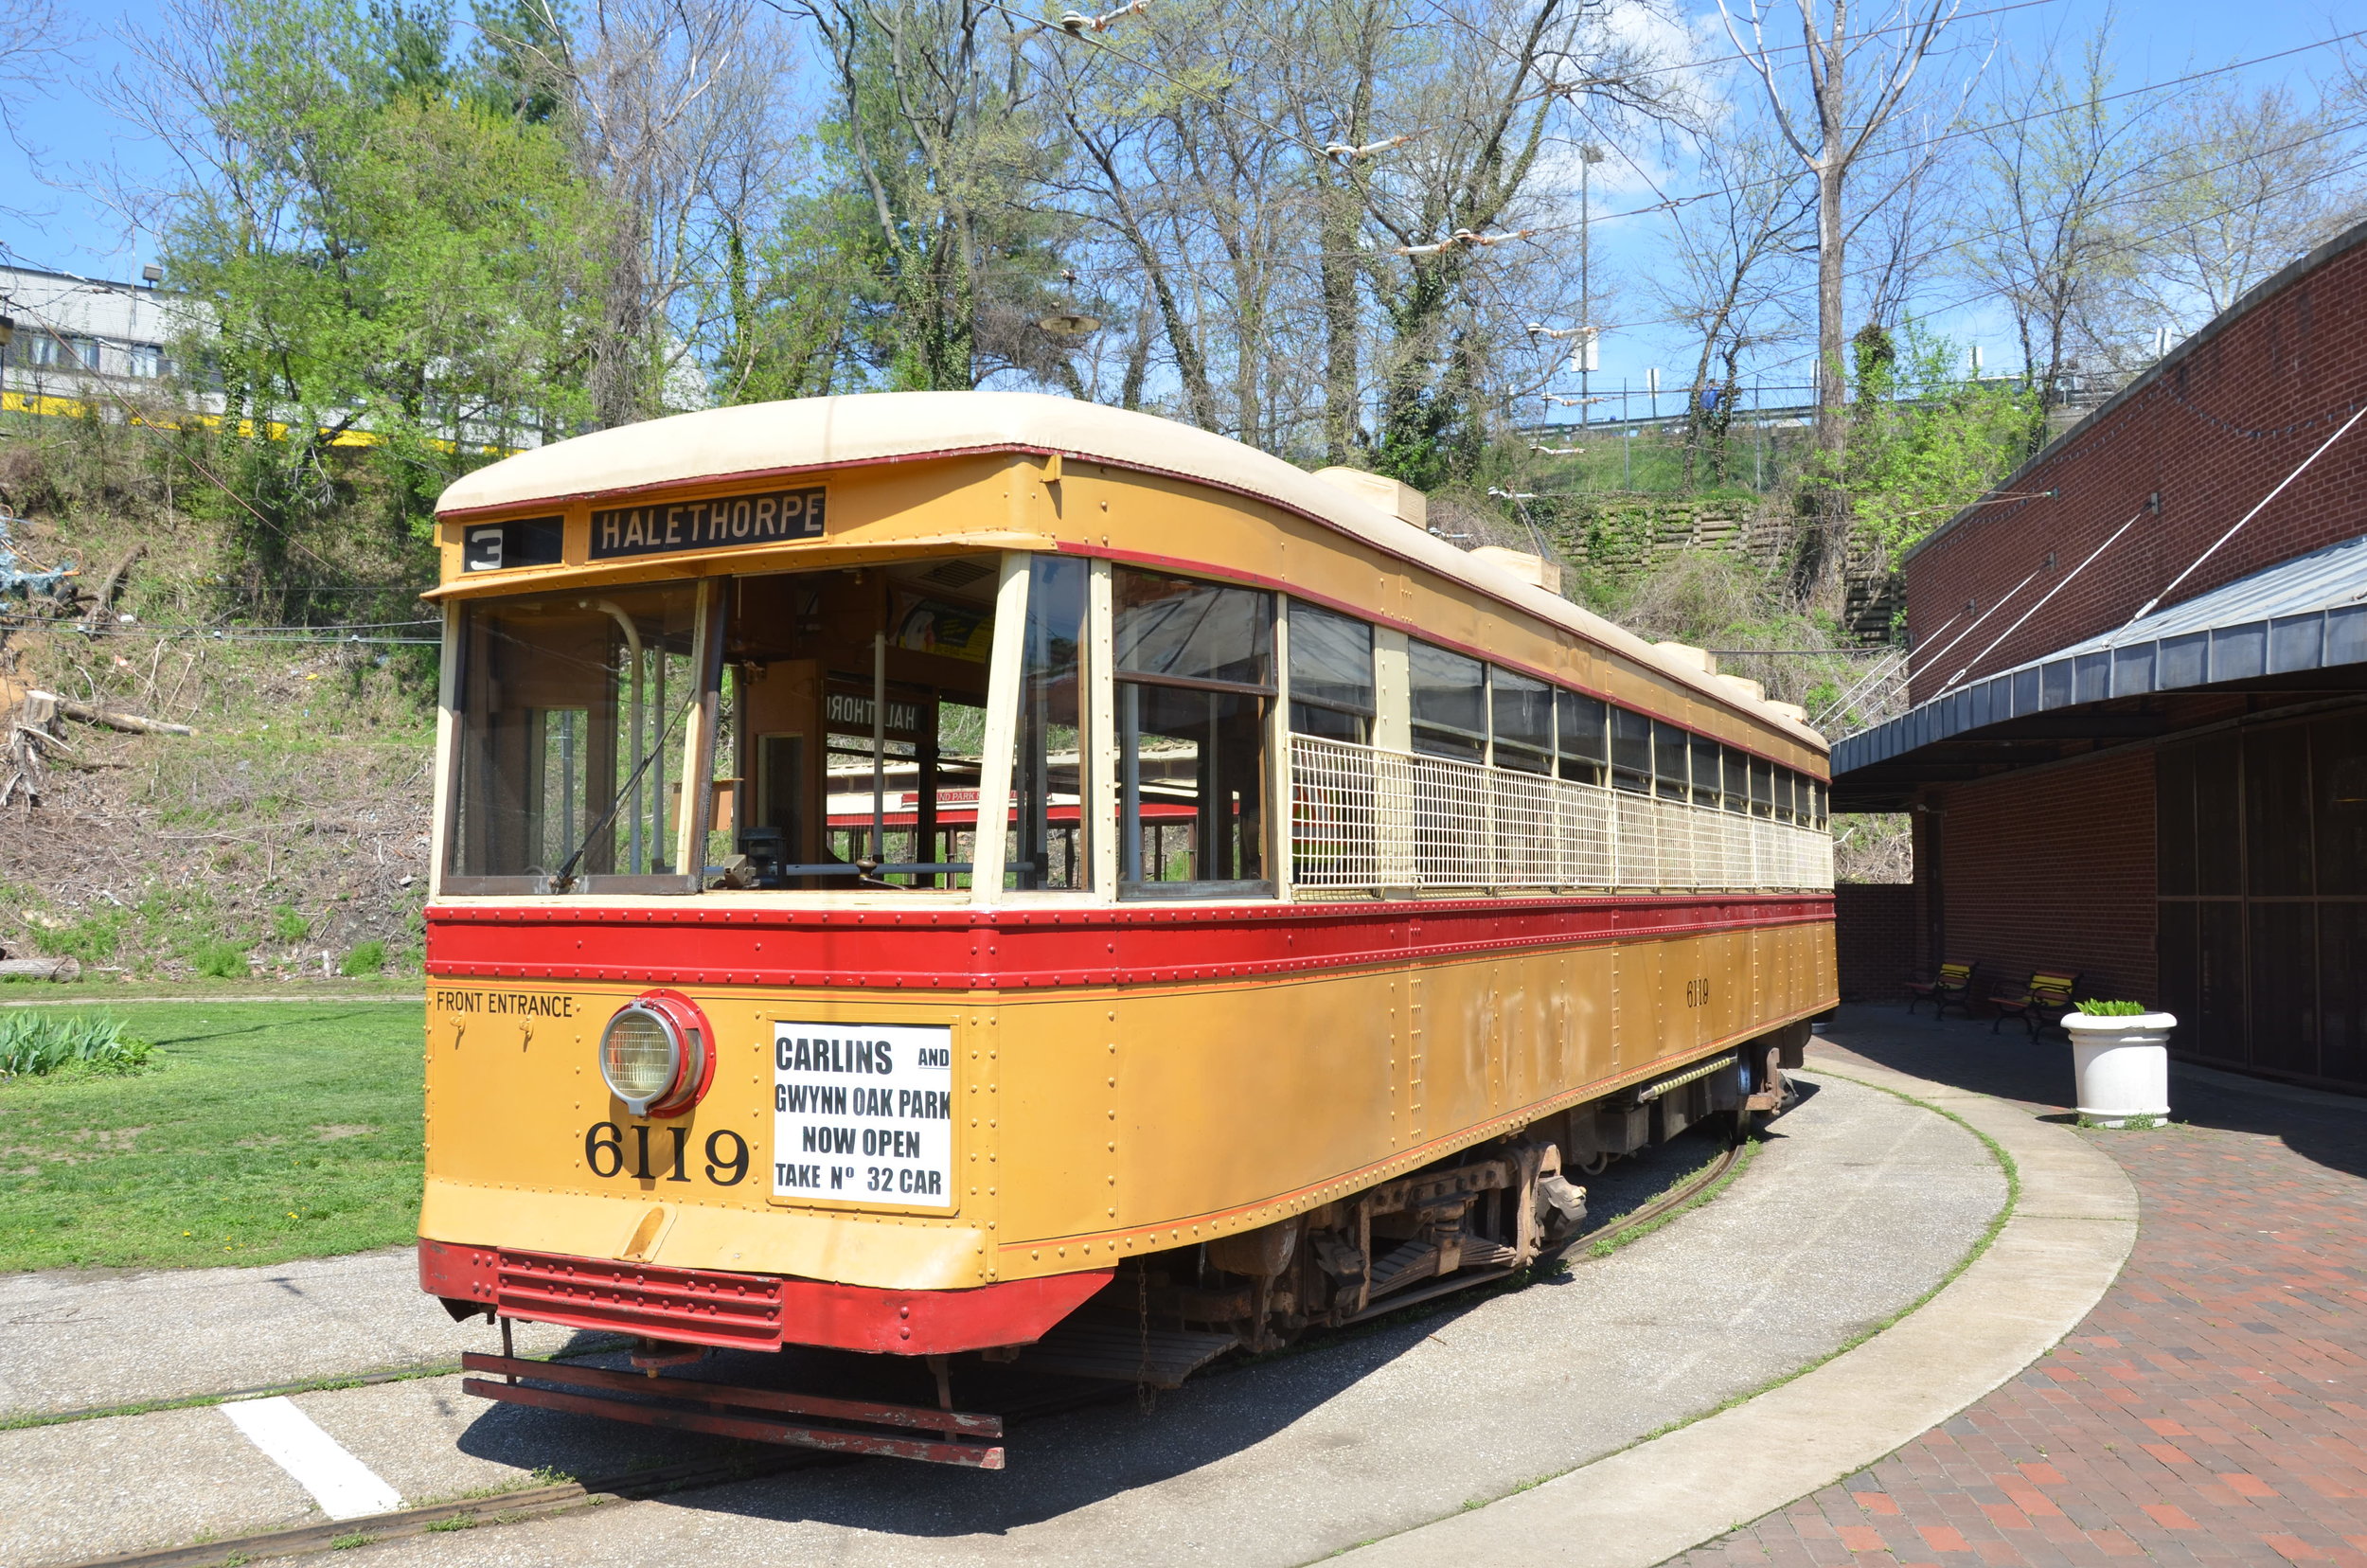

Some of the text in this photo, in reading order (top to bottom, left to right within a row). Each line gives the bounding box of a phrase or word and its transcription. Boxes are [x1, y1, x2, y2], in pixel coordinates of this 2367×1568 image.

[470, 492, 825, 571] 3 HALETHORPE
[436, 990, 573, 1018] FRONT ENTRANCE
[1686, 978, 1709, 1008] 6119
[775, 1037, 950, 1076] CARLINS AND
[774, 1083, 951, 1120] GWYNN OAK PARK
[584, 1121, 750, 1186] 6119
[802, 1125, 920, 1159] NOW OPEN
[774, 1163, 821, 1188] TAKE
[867, 1167, 894, 1192] 32
[899, 1168, 941, 1195] CAR
